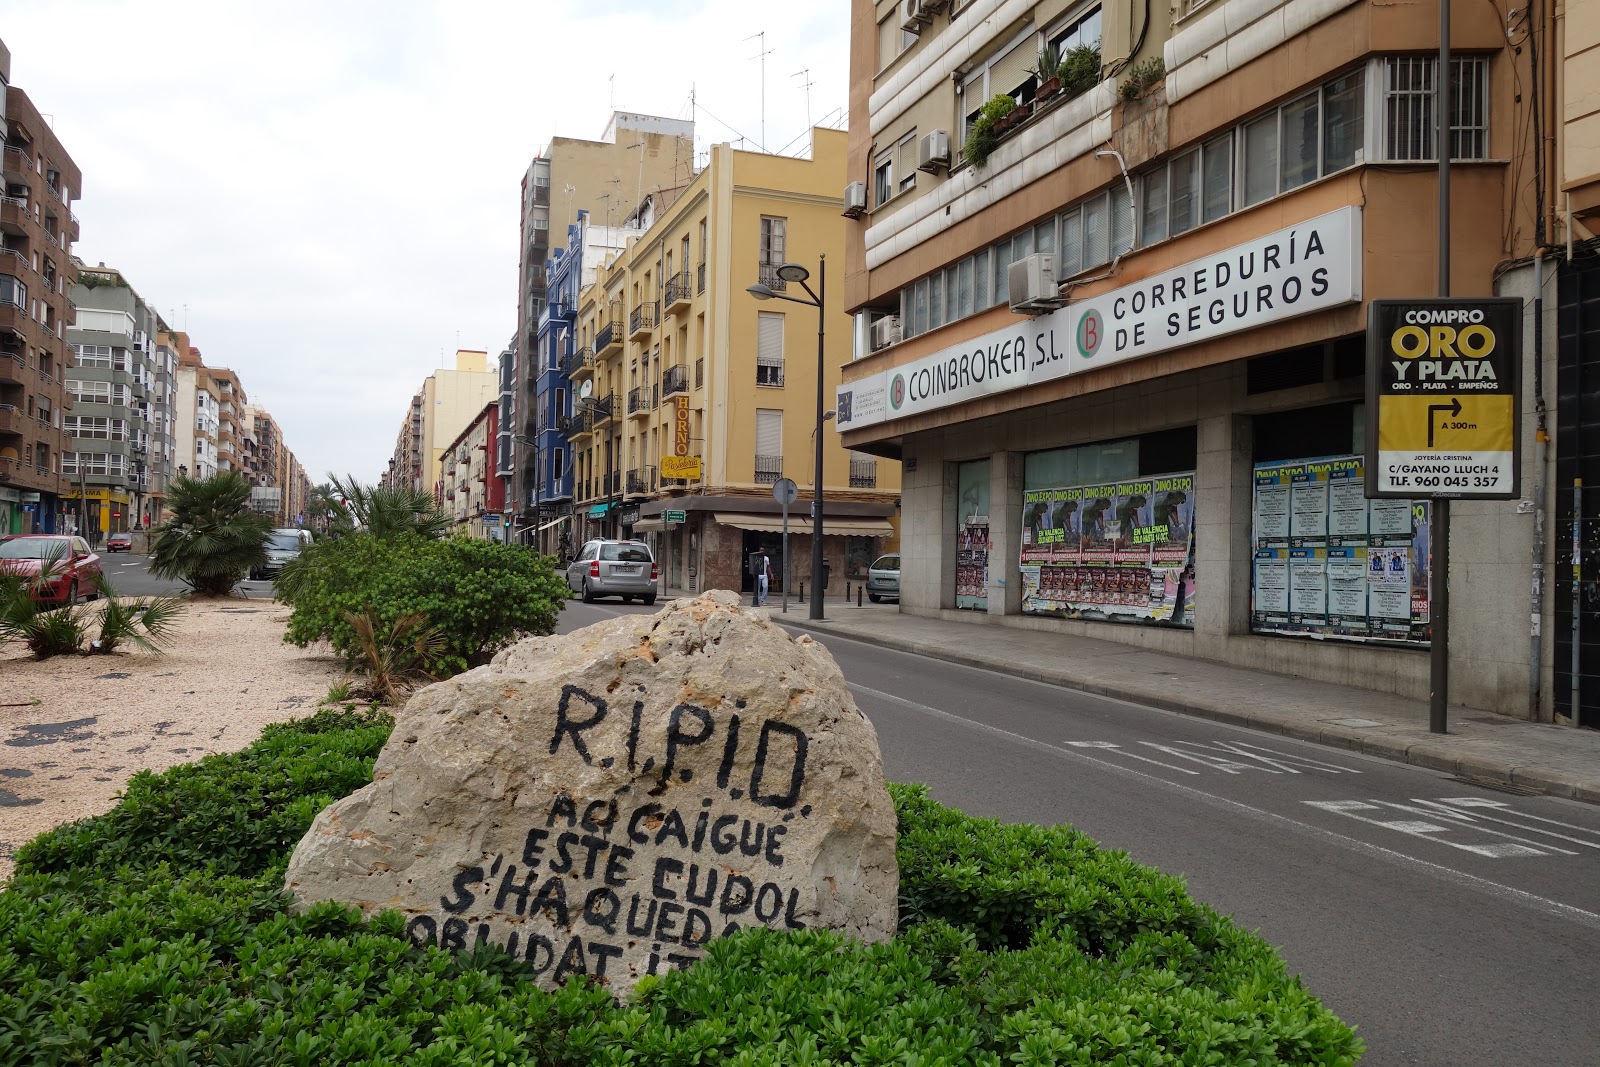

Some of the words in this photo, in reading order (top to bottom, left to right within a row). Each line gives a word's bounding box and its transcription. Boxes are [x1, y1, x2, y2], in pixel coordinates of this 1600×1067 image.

[1113, 230, 1325, 320] CORREDURÍA
[1115, 322, 1145, 351] DE
[1167, 268, 1329, 337] SEGUROS
[1405, 309, 1485, 324] COMPRO
[1391, 325, 1496, 359] ORO
[1392, 361, 1411, 380] Y
[1419, 360, 1497, 380] PLATA
[1422, 382, 1447, 390] PLATA
[1458, 381, 1499, 390] EMPEÑOS
[676, 396, 689, 456] HORNO
[1389, 465, 1451, 474] C/GAYANO
[1454, 465, 1488, 474] LLUCH
[1492, 465, 1499, 474] 4
[1154, 479, 1172, 492] DINO
[1172, 477, 1192, 490] EXPO
[1389, 476, 1411, 486] TLF.
[1414, 476, 1440, 487] 960
[1443, 477, 1469, 487] 045
[1473, 477, 1500, 487] 357
[69, 489, 102, 497] FORMA
[1054, 490, 1067, 502] DINO
[1067, 489, 1083, 500] EXPO
[1084, 487, 1099, 499] DINO
[1100, 485, 1116, 497] EXPO
[1118, 484, 1133, 496] DINO
[1134, 482, 1152, 495] EXPO
[1026, 493, 1039, 503] DINO
[1039, 490, 1053, 502] EXPO
[1045, 528, 1065, 536] VALENCIA
[1133, 528, 1141, 536] EN
[1142, 525, 1169, 534] VALENCIA
[1142, 533, 1155, 543] HASTA
[522, 827, 636, 888] ESTE
[652, 857, 807, 931] CUDOL
[583, 886, 743, 950] QUED
